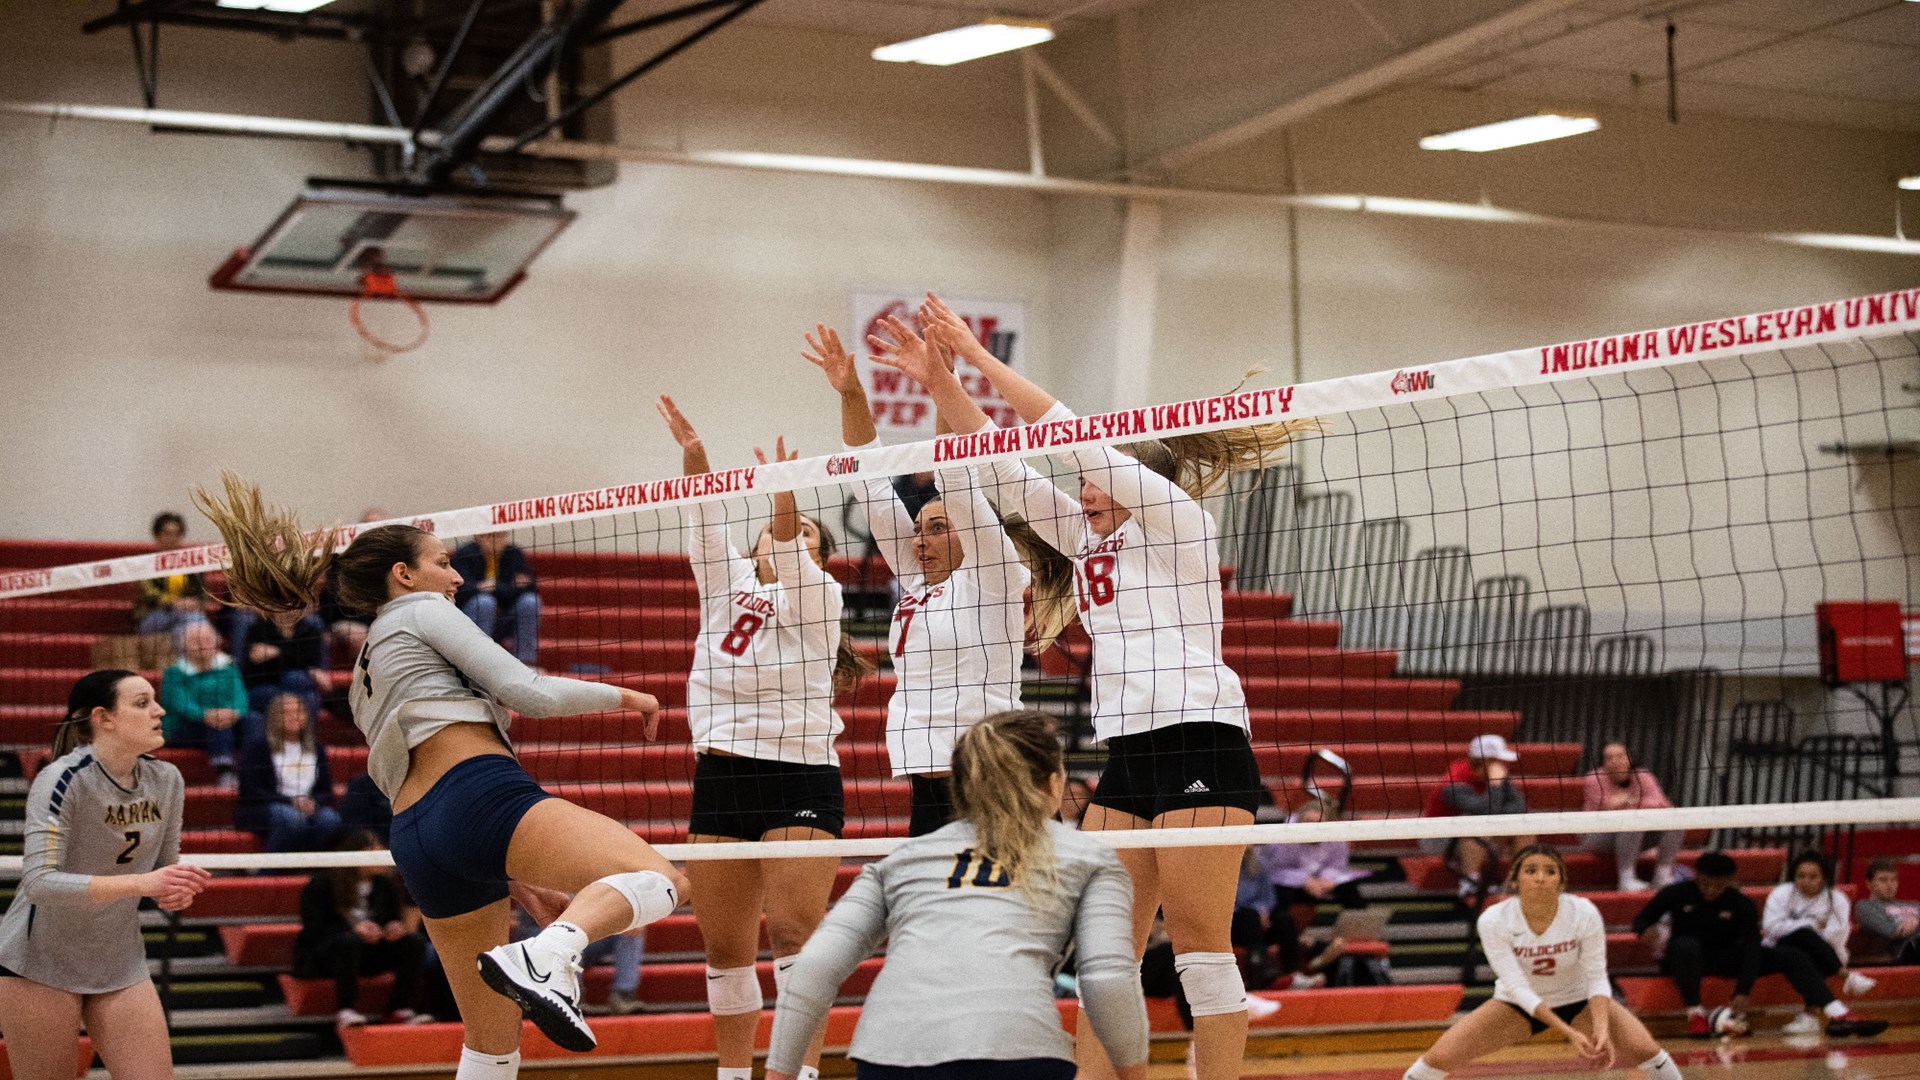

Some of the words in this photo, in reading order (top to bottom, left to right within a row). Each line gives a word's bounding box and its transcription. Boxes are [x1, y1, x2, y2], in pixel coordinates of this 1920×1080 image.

[1540, 331, 1659, 375] INDIANA
[1667, 303, 1837, 356] WESLEYAN
[1845, 289, 1920, 329] UNIV
[934, 427, 1022, 463] INDIANA
[1025, 408, 1147, 449] WESLEYAN
[1151, 386, 1295, 432] UNIVERSITY
[491, 496, 556, 525] INDIANA
[558, 483, 648, 516] WESLEYAN
[651, 467, 756, 503] UNIVERSITY
[720, 613, 764, 657] 8
[894, 608, 916, 658] 7
[116, 831, 141, 864] 2
[1513, 939, 1578, 958] WILDCATS
[1531, 957, 1556, 976] 2
